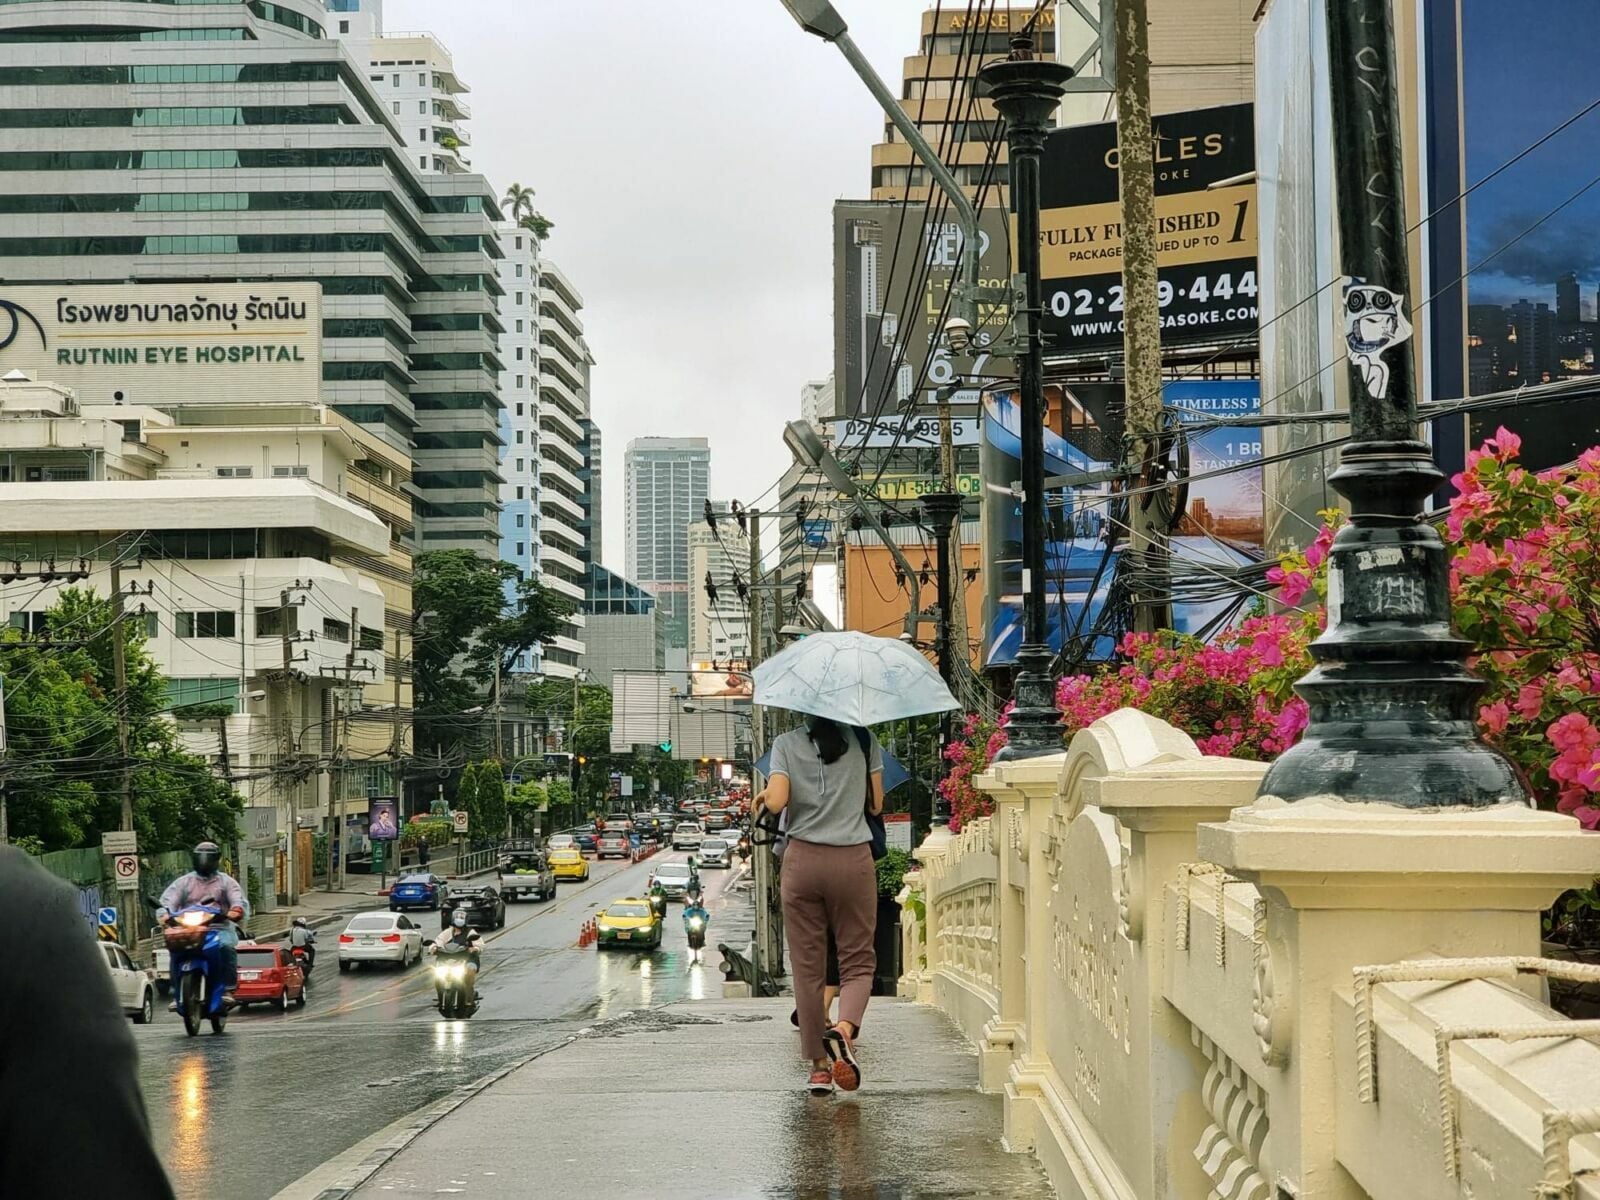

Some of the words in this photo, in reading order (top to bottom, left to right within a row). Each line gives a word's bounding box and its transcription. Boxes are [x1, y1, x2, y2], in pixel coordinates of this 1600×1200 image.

[950, 13, 1008, 28] ASOKE
[1104, 133, 1222, 169] CLES
[1039, 225, 1098, 247] FULLY
[1183, 237, 1200, 250] UP
[1203, 235, 1220, 247] TO
[57, 295, 238, 331] โรงพยาบาลจักษุ
[245, 295, 306, 321] รัตนิน
[57, 347, 138, 366] RUTNIN
[145, 346, 188, 364] EYE
[196, 345, 305, 363] HOSPITAL
[1171, 397, 1248, 410] TIMELESS
[1226, 442, 1233, 456] 1
